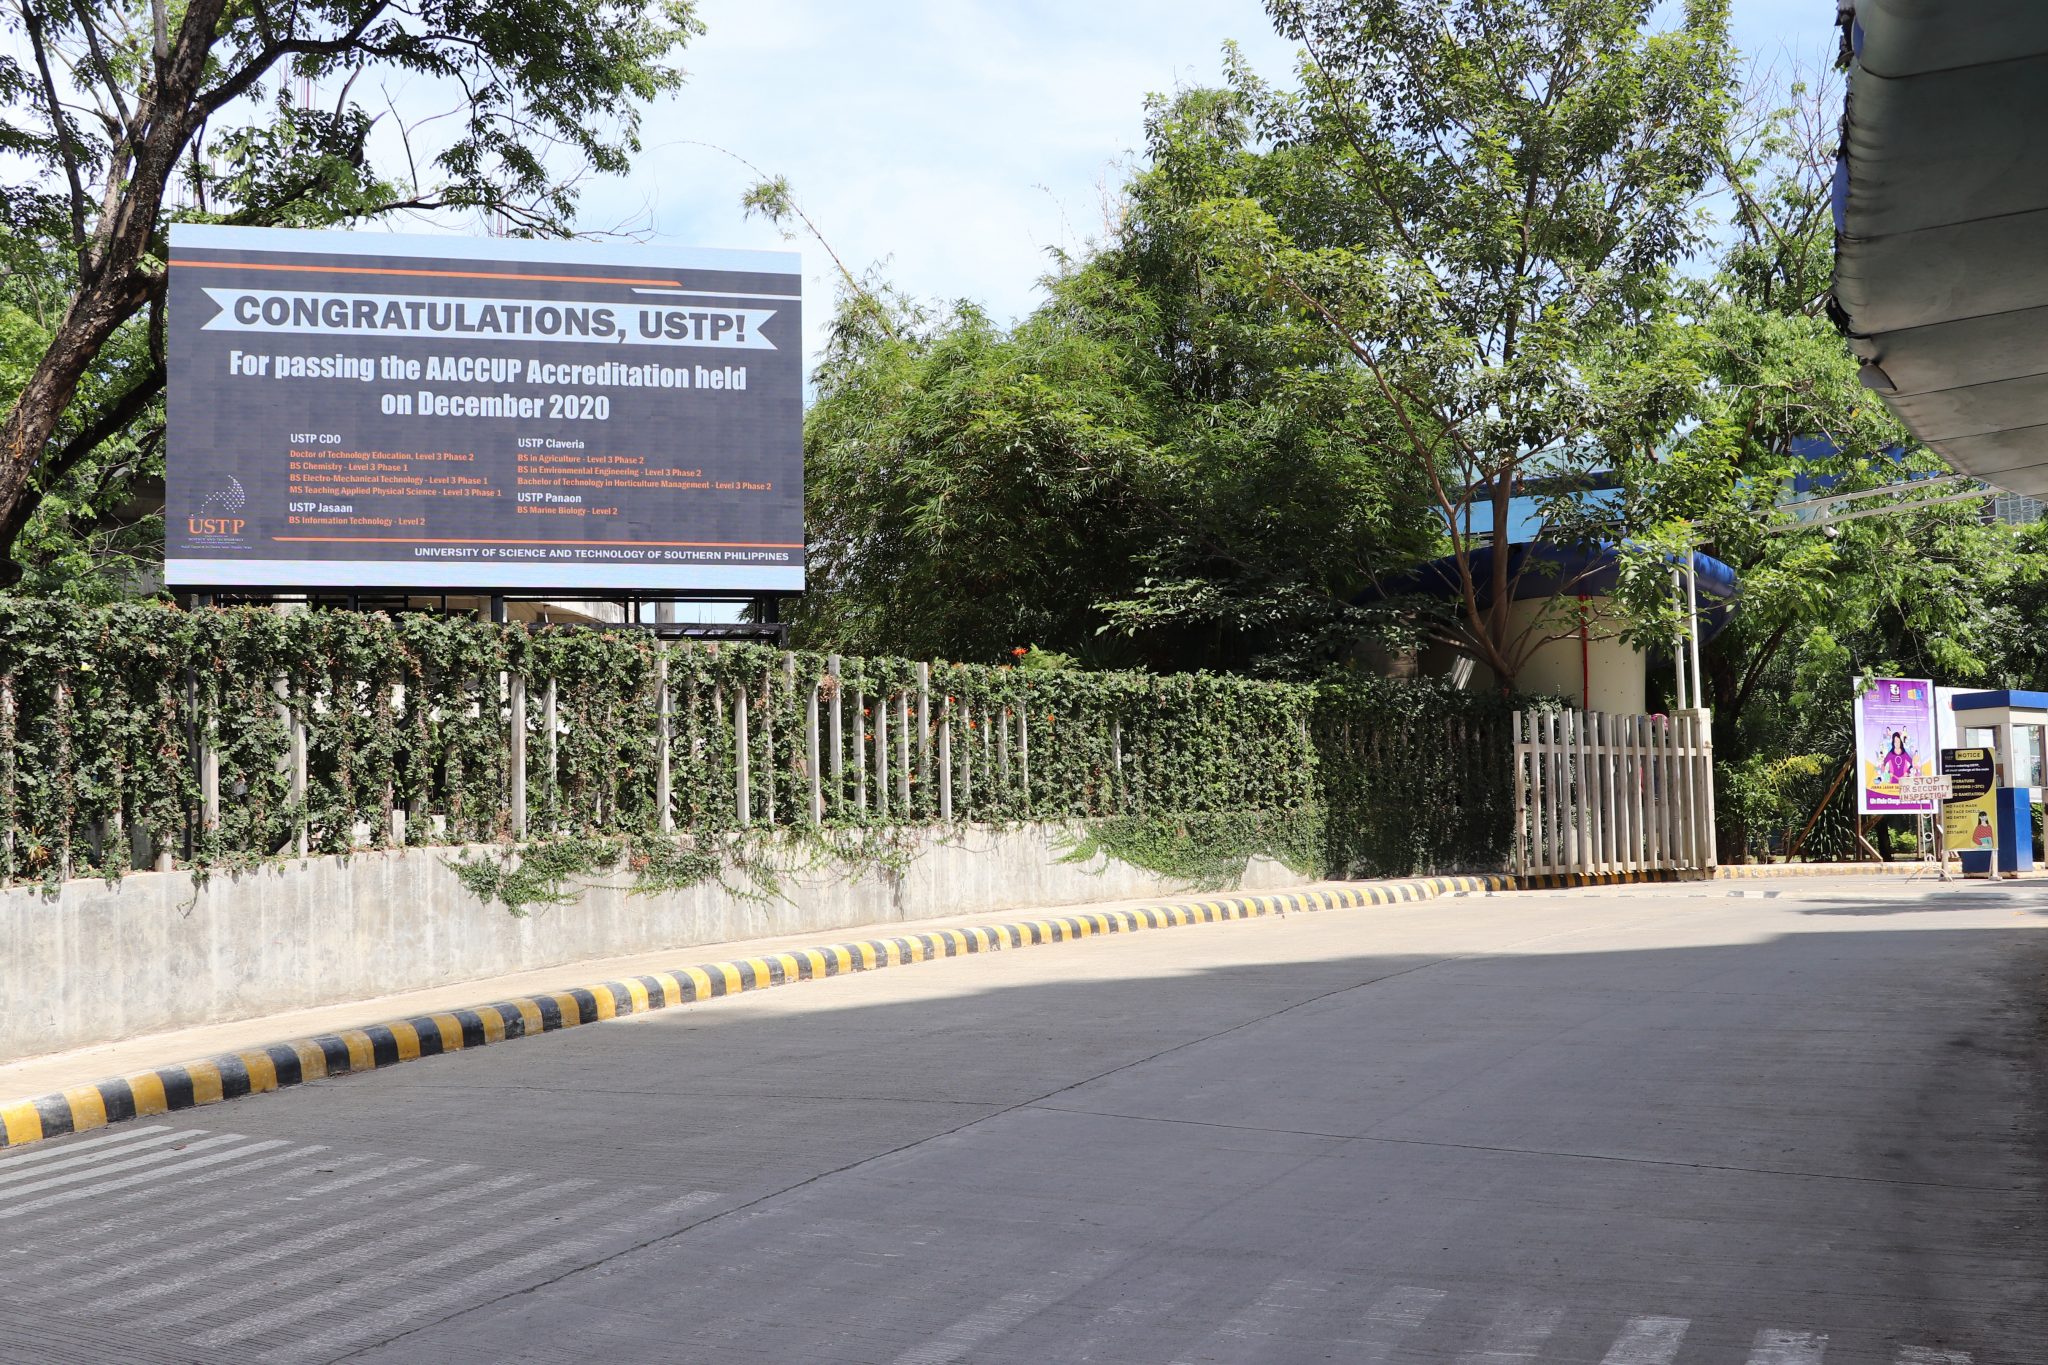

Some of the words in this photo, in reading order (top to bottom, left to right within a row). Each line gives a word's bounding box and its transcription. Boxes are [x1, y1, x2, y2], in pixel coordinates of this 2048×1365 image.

[234, 295, 626, 344] CONGRATULATIONS,
[639, 310, 746, 342] USTP!
[230, 351, 270, 375] For
[275, 354, 374, 381] passing
[381, 356, 420, 380] the
[426, 357, 521, 382] AACCUP
[527, 360, 689, 388] Accreditation
[696, 365, 746, 390] held
[381, 393, 411, 415] on
[418, 392, 544, 418] December
[549, 396, 609, 420] 2020
[291, 434, 317, 444] USTP
[320, 435, 341, 444] CDO
[518, 439, 544, 448] USTP
[546, 439, 584, 449] Claveria
[328, 451, 370, 460] Technology
[372, 452, 413, 460] Education,
[539, 455, 581, 464] Agriculture
[615, 456, 638, 464] Phase
[303, 463, 342, 472] Chemistry
[539, 466, 593, 474] Environmental
[594, 468, 639, 477] Engineering
[303, 475, 379, 483] Electro-Mechanical
[381, 476, 423, 485] Technology
[553, 478, 561, 486] of
[563, 479, 604, 488] Technology
[606, 479, 613, 487] in
[614, 479, 659, 488] Horticulture
[661, 480, 709, 490] Management
[742, 482, 765, 490] Phase
[304, 486, 340, 495] Teaching
[341, 487, 370, 496] Applied
[372, 487, 404, 496] Physical
[518, 492, 543, 502] USTP
[545, 493, 582, 503] Panaon
[289, 503, 316, 512] USTP
[318, 503, 352, 513] Jasaan
[530, 506, 557, 514] Marine
[558, 507, 586, 516] Biology
[188, 519, 245, 534] USTP
[302, 517, 348, 525] Information
[350, 517, 392, 527] Technology
[415, 548, 479, 557] UNIVERSITY
[482, 549, 497, 557] OF
[499, 548, 546, 558] SCIENCE
[549, 550, 572, 558] AND
[575, 550, 645, 559] TECHNOLOGY
[648, 550, 662, 559] OF
[664, 550, 721, 560] SOUTHERN
[724, 551, 789, 561] PHILIPPINES
[1914, 777, 1940, 785] STOP
[1900, 785, 1911, 793] FOR
[1900, 792, 1947, 800] INSPECTION
